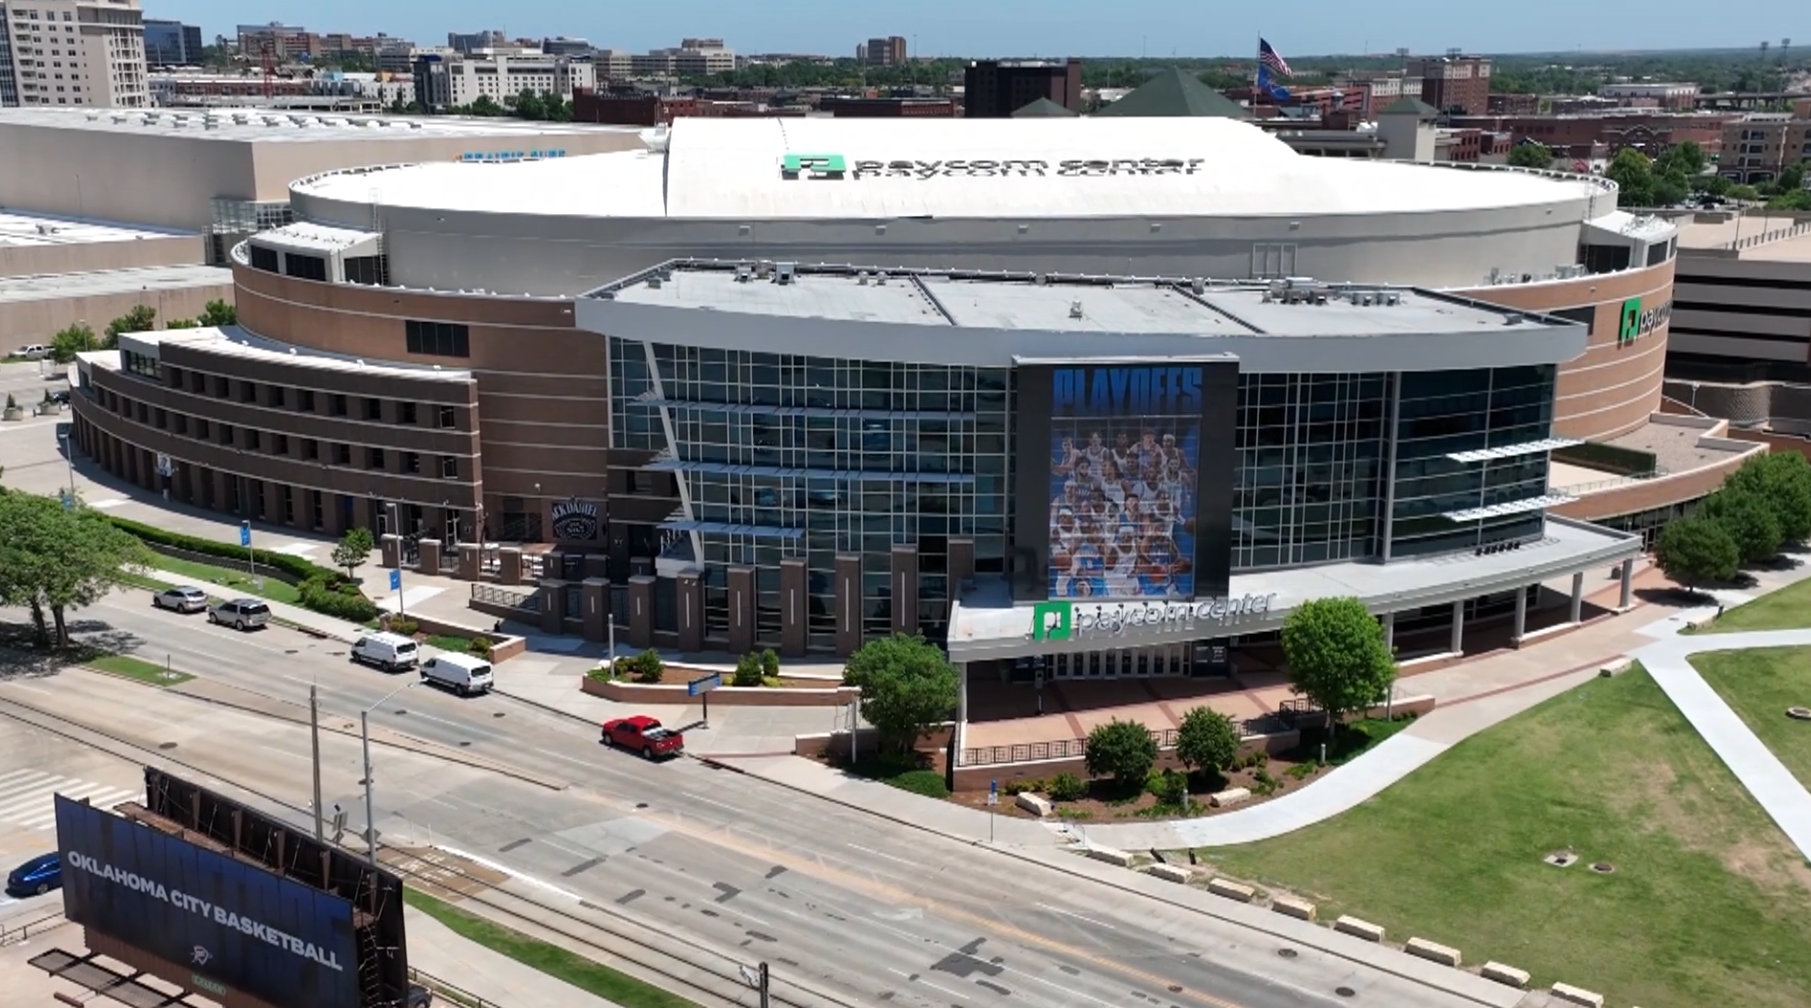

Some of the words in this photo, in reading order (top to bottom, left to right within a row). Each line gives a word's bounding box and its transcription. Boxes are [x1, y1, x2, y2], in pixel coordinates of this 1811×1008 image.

[852, 160, 1048, 179] paycom
[1058, 158, 1205, 177] center
[1053, 367, 1203, 417] PLAYOFFS
[1078, 605, 1190, 638] paycom
[1197, 592, 1277, 619] center
[68, 851, 168, 902] OKLAHOMA
[171, 890, 211, 918] CITY
[214, 905, 343, 972] BASKETBALL
